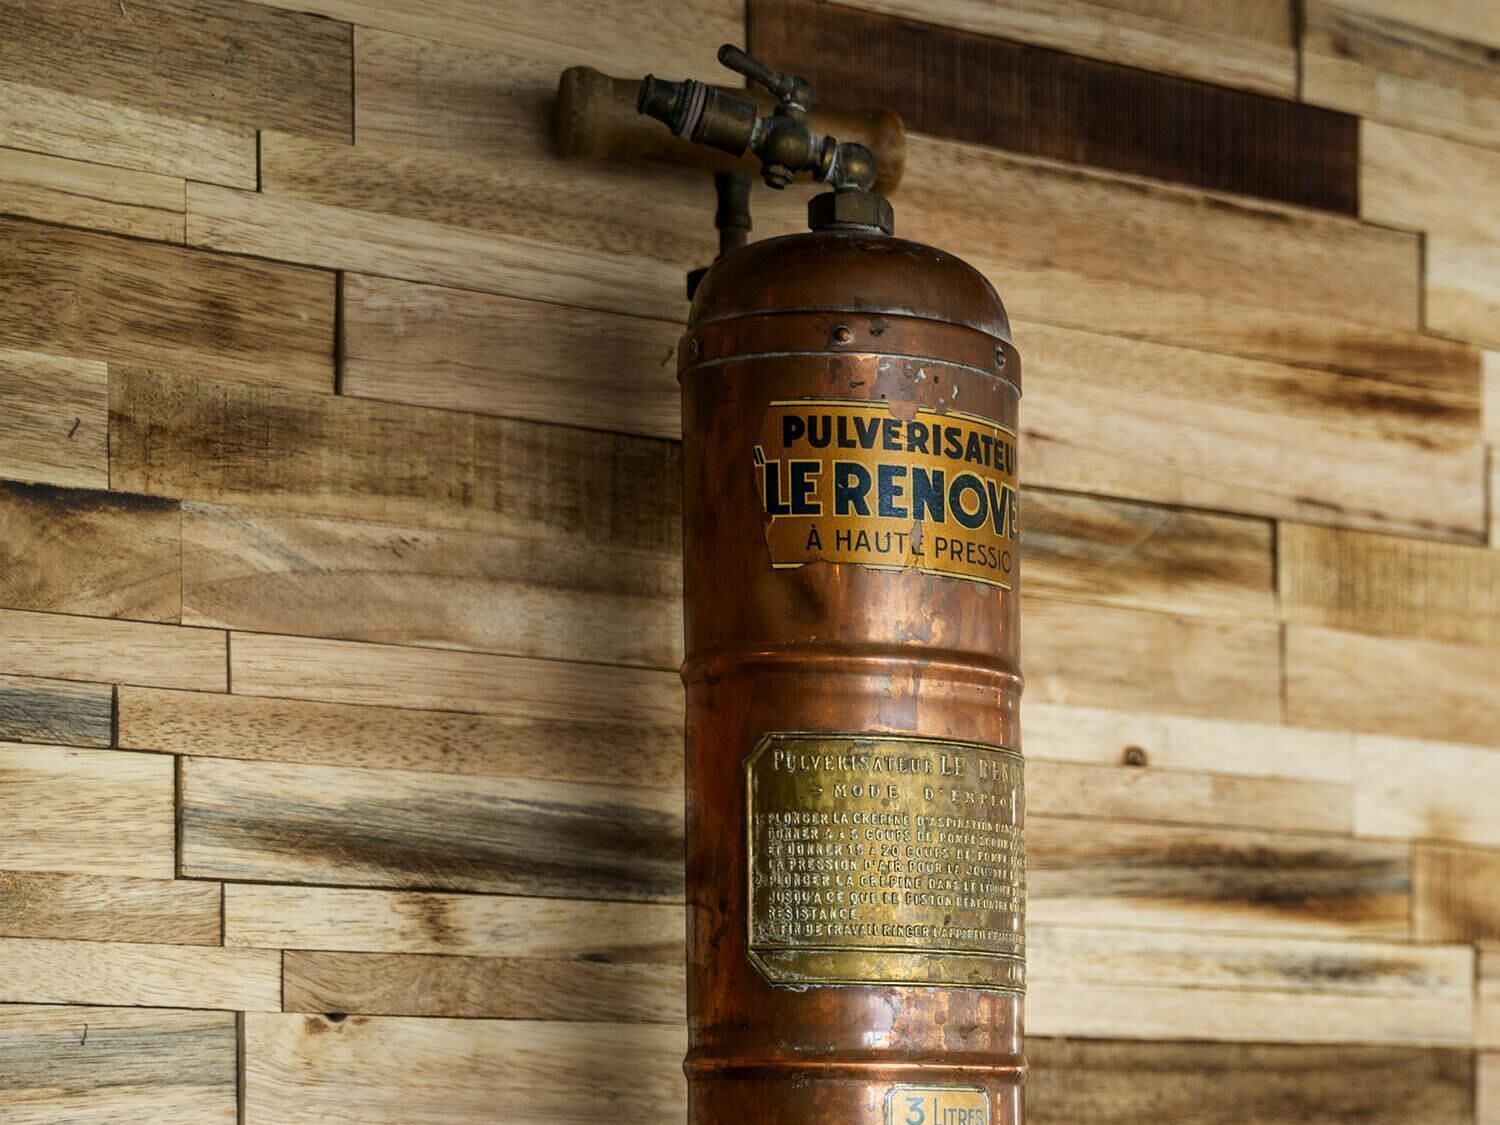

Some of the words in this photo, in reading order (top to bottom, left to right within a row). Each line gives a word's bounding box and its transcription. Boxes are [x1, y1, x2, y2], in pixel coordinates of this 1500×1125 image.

[783, 415, 1017, 476] PULVERISATEU
[806, 524, 822, 550] À
[773, 750, 933, 774] PULVERISATEUR
[939, 755, 964, 776] LE
[833, 783, 899, 799] MODE
[767, 811, 829, 825] PLONGER
[832, 811, 848, 824] LA
[864, 828, 911, 842] COUPS
[917, 830, 934, 841] DE
[880, 844, 899, 857] 20
[905, 846, 949, 859] COUPS
[788, 856, 859, 871] PRESSION
[863, 859, 902, 872] D'AIR
[907, 860, 943, 875] POUR
[768, 872, 830, 887] PLONGER
[834, 874, 855, 887] LA
[927, 876, 961, 890] DANS
[825, 891, 845, 903] CE
[849, 891, 879, 905] QUE
[905, 892, 953, 906] PISTON
[825, 923, 880, 937] TRAVAIL
[881, 924, 931, 938] RINCER
